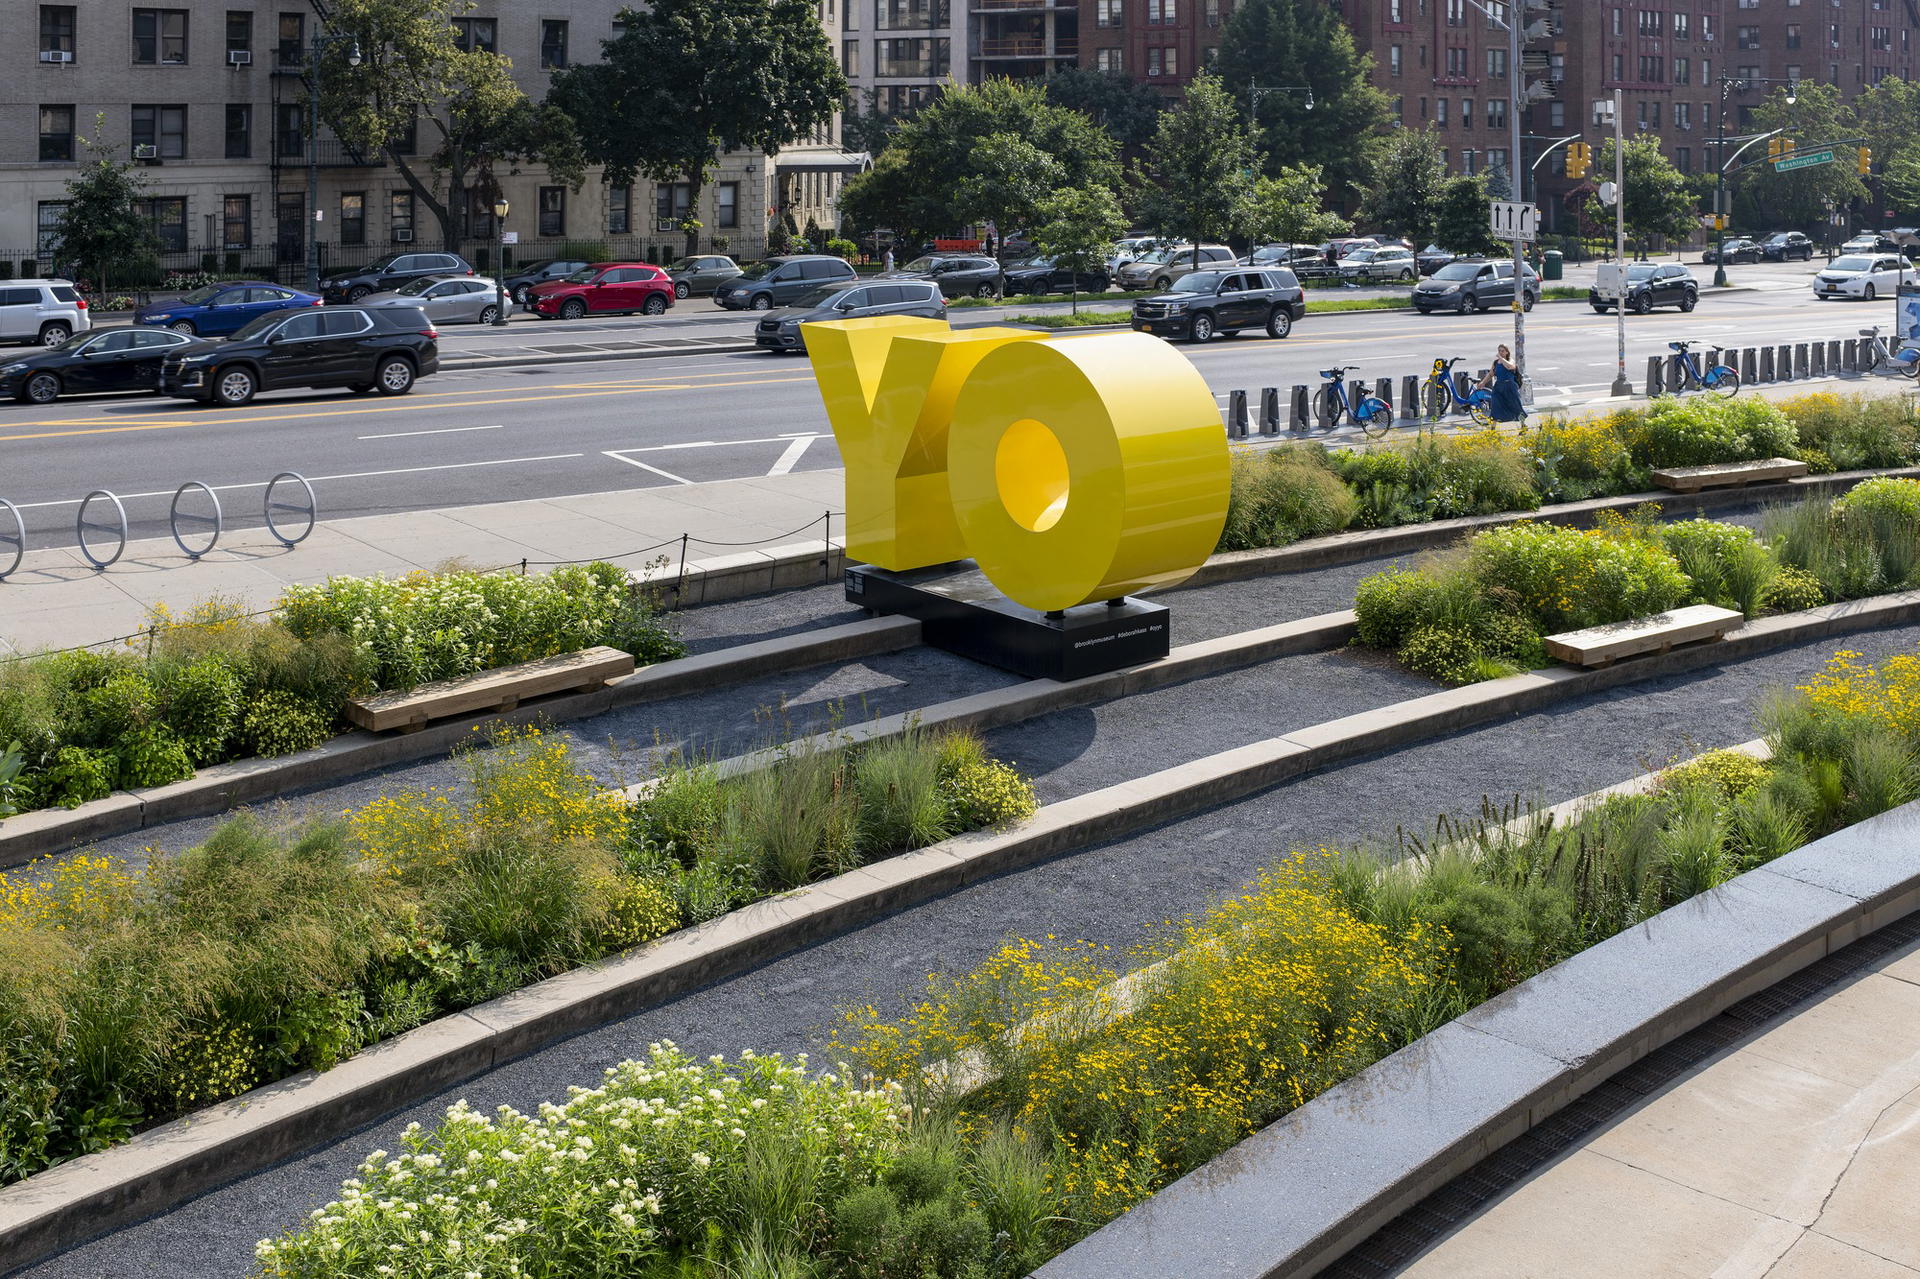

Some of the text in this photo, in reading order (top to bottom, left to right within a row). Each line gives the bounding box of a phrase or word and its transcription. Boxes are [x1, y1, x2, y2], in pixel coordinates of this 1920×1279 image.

[1779, 157, 1818, 169] Washington
[1519, 231, 1532, 239] ONLY
[800, 319, 1150, 612] YO
